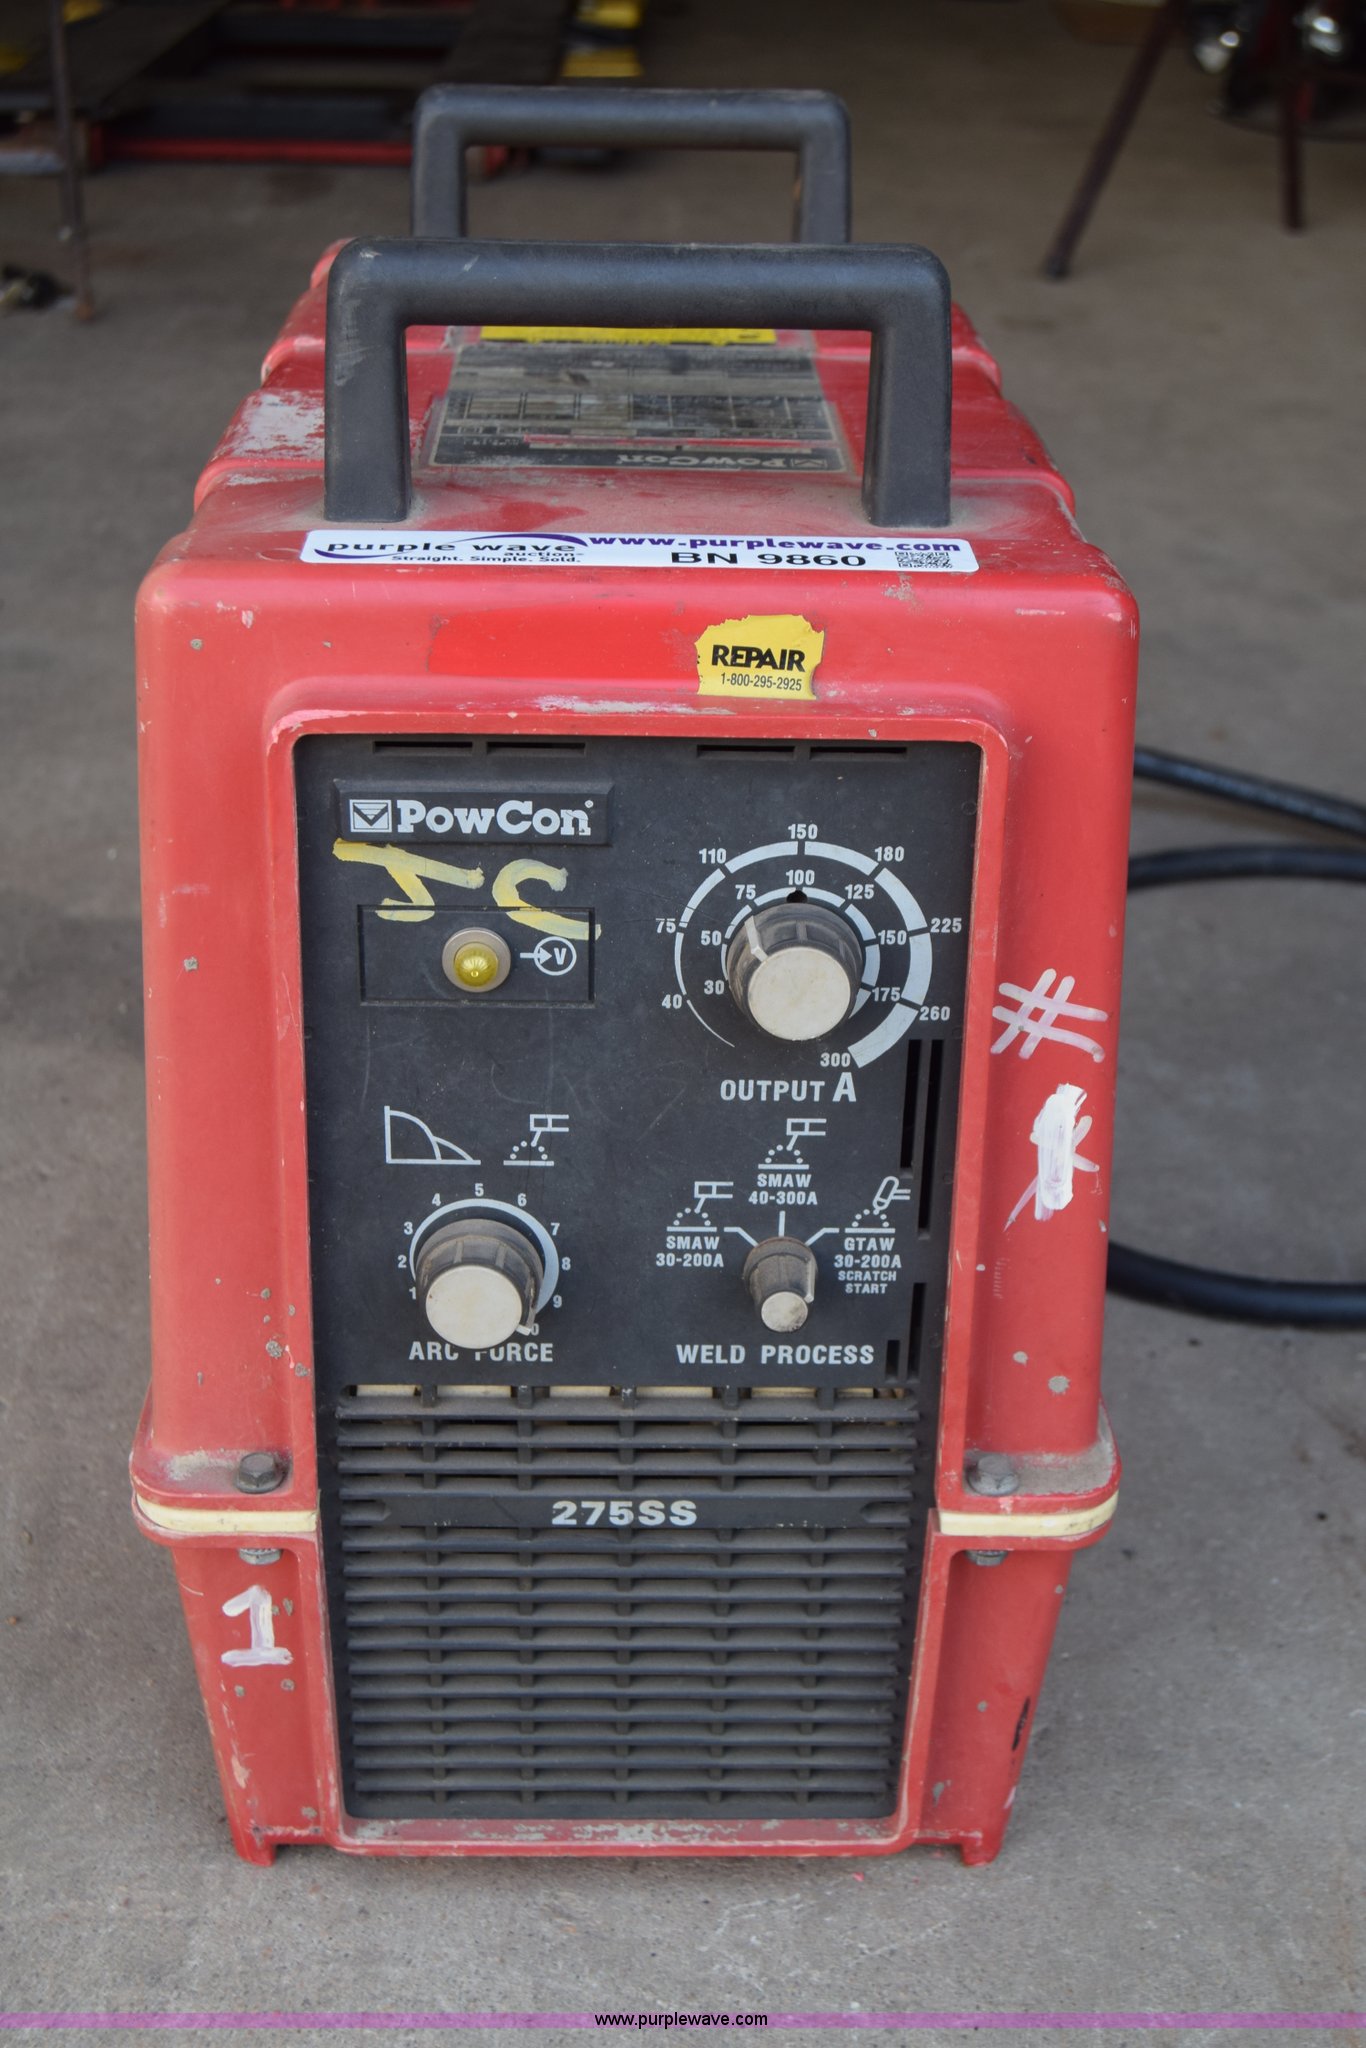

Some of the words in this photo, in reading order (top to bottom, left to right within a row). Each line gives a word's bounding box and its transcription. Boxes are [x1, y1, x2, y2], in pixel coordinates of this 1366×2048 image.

[617, 452, 787, 468] PowCon
[327, 542, 456, 552] purple
[473, 543, 576, 552] wave
[589, 537, 960, 552] www.purplewave.com
[671, 551, 738, 565] BN
[757, 553, 866, 567] 9860
[711, 644, 806, 672] REPAIR
[720, 672, 802, 691] 1-800-295-2925
[397, 799, 592, 836] PowCon
[788, 824, 818, 839] 150
[699, 848, 727, 864] 110
[875, 846, 905, 862] 180
[786, 870, 815, 886] 100
[735, 884, 756, 900] 75
[844, 884, 874, 900] 125
[656, 918, 676, 934] 75
[930, 918, 962, 933] 225
[701, 931, 722, 946] 50
[878, 930, 907, 945] 150
[553, 947, 567, 965] V
[704, 980, 725, 995] 30
[872, 987, 900, 1002] 175
[661, 994, 682, 1009] 40
[919, 1006, 950, 1021] 260
[820, 1053, 850, 1067] 300
[720, 1079, 825, 1102] OUTPUT
[832, 1071, 857, 1103] A
[757, 1173, 812, 1188] SMAW
[474, 1183, 484, 1196] 5
[431, 1193, 441, 1206] 4
[517, 1193, 527, 1206] 6
[748, 1190, 818, 1205] 40-300A
[403, 1222, 413, 1235] 3
[550, 1223, 560, 1236] 7
[666, 1236, 720, 1250] SMAW
[844, 1237, 895, 1251] GTAW
[397, 1255, 407, 1268] 2
[561, 1257, 571, 1271] 8
[656, 1253, 724, 1268] 30-200A
[834, 1254, 902, 1269] 30-200A
[838, 1270, 897, 1282] SCRATCH
[845, 1283, 888, 1294] START
[552, 1295, 562, 1308] 9
[676, 1344, 746, 1364] WELD
[761, 1344, 875, 1365] PROCESS
[552, 1500, 697, 1526] 275SS
[221, 1584, 294, 1667] 1
